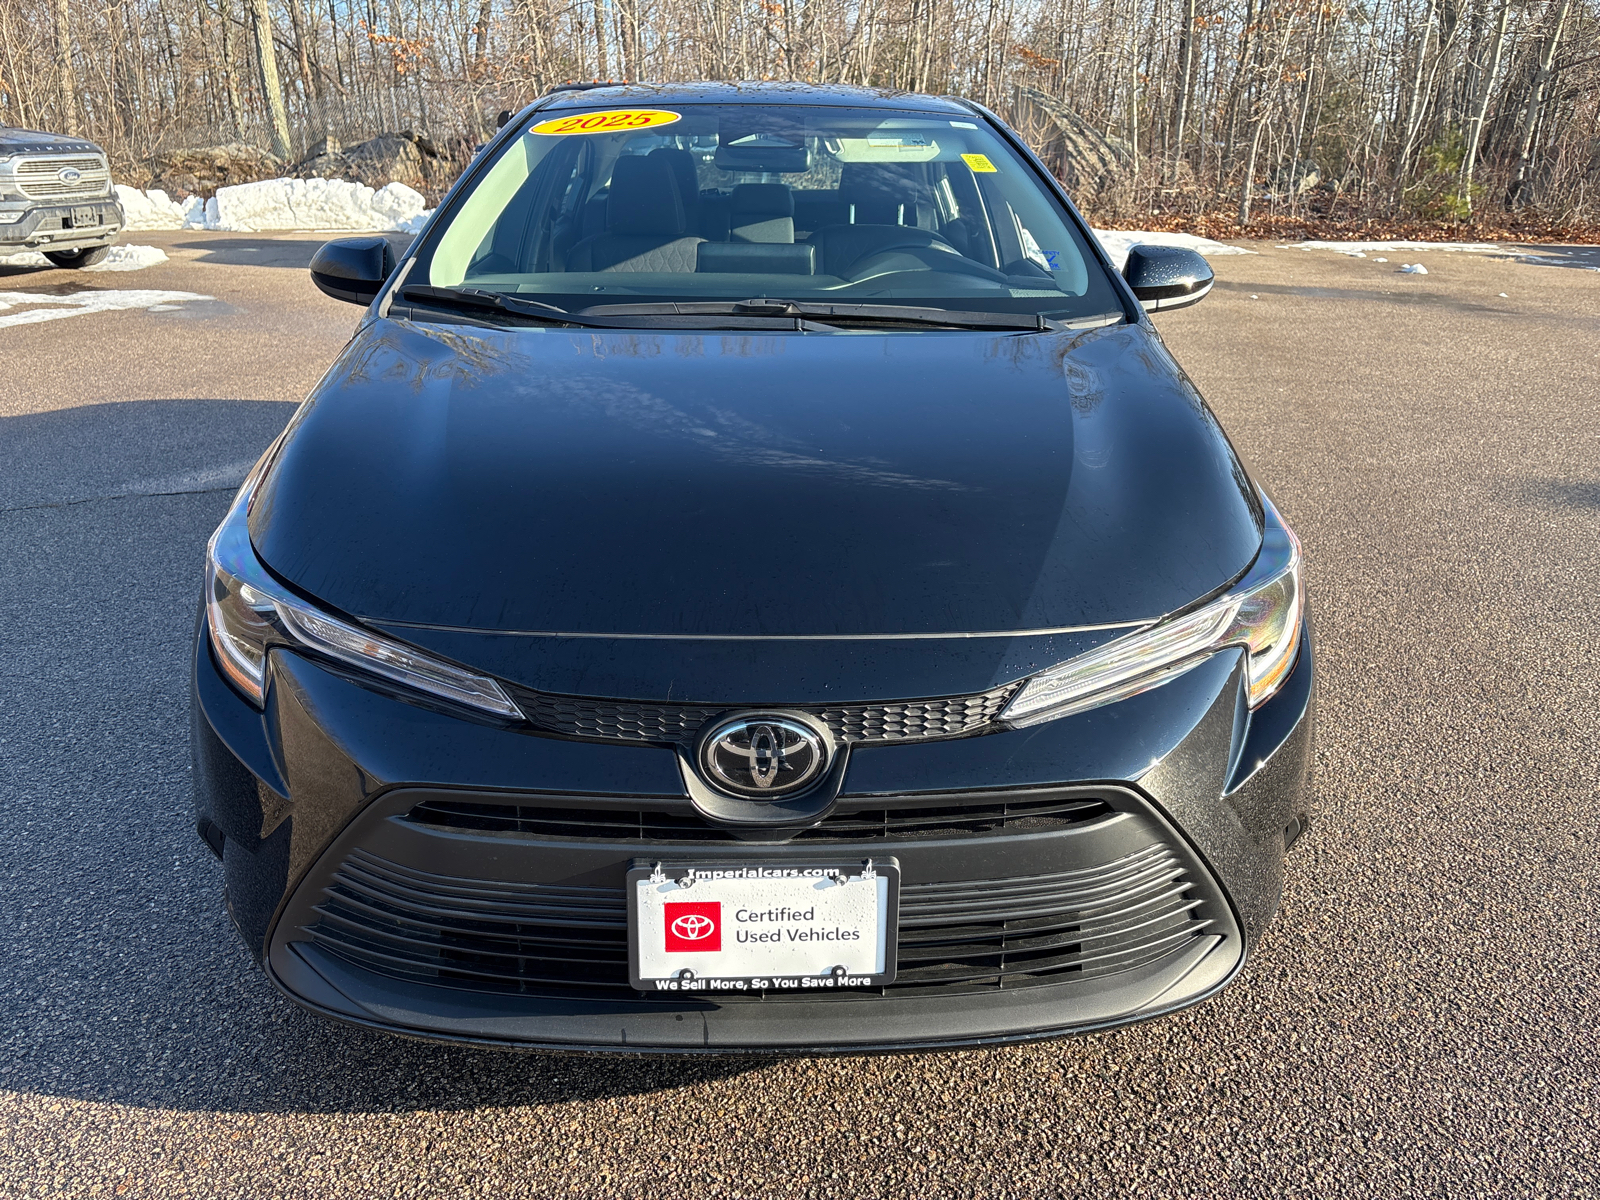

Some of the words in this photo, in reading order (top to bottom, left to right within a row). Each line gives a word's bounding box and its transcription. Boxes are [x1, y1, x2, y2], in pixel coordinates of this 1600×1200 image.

[553, 113, 657, 132] 2025
[687, 868, 840, 880] Imperialcars.com
[735, 906, 814, 922] Certified
[736, 928, 781, 943] Used
[786, 927, 860, 941] Vehicles
[655, 980, 678, 990] We
[681, 979, 706, 990] Sell
[710, 979, 747, 990] More,
[751, 979, 769, 989] So
[772, 978, 798, 988] You
[801, 977, 834, 987] Save
[837, 976, 871, 986] More
